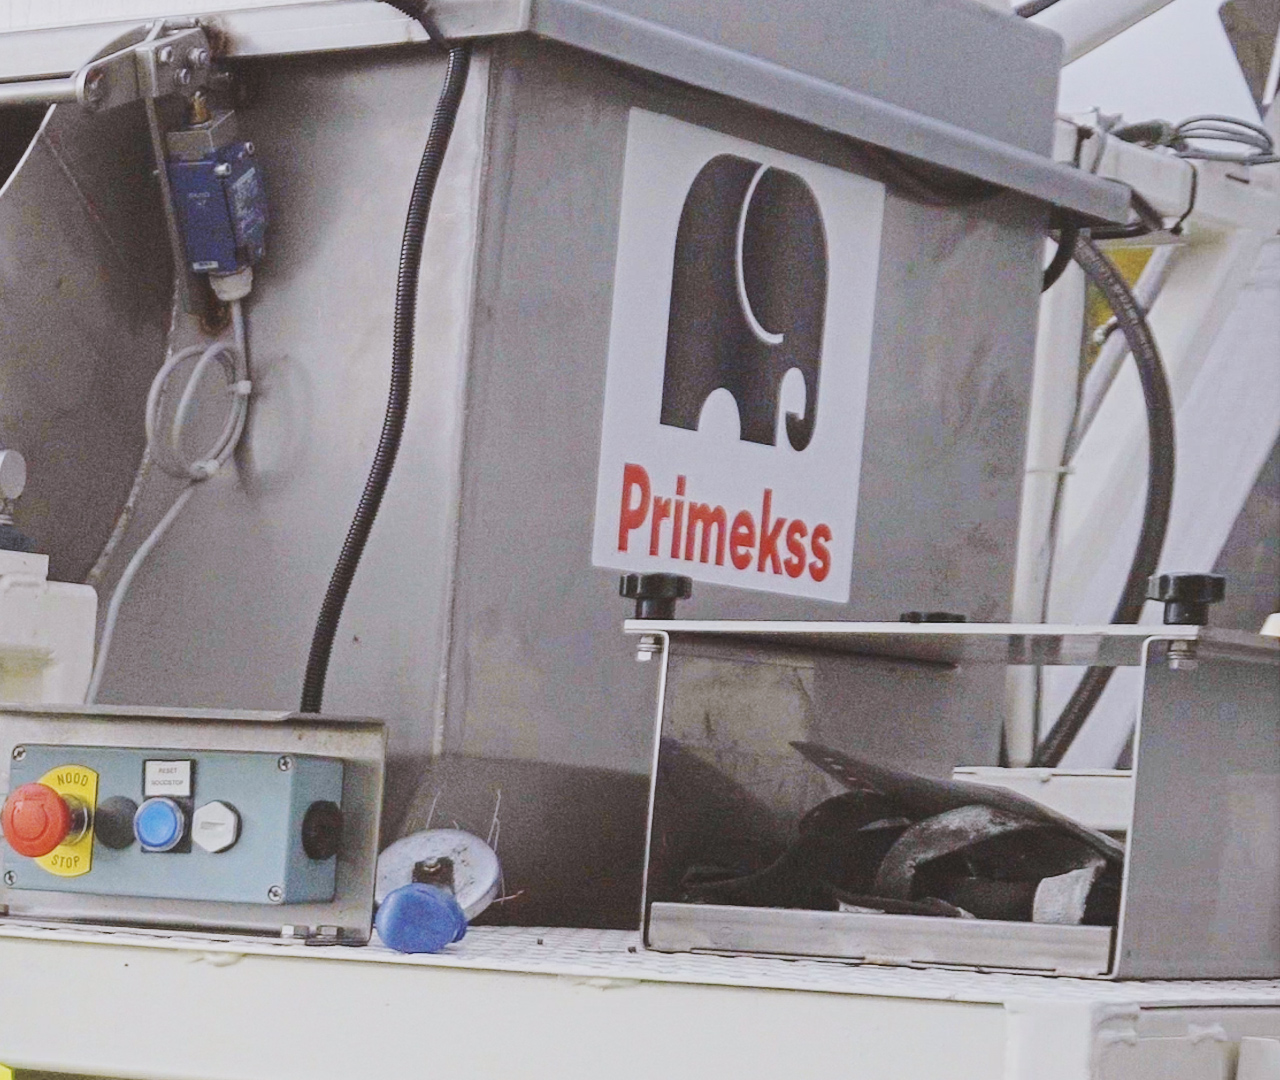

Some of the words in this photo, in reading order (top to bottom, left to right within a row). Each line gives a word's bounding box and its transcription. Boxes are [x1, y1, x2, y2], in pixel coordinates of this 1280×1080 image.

[618, 462, 833, 582] Primekss
[57, 772, 89, 787] NOOD
[51, 854, 81, 869] STOP
